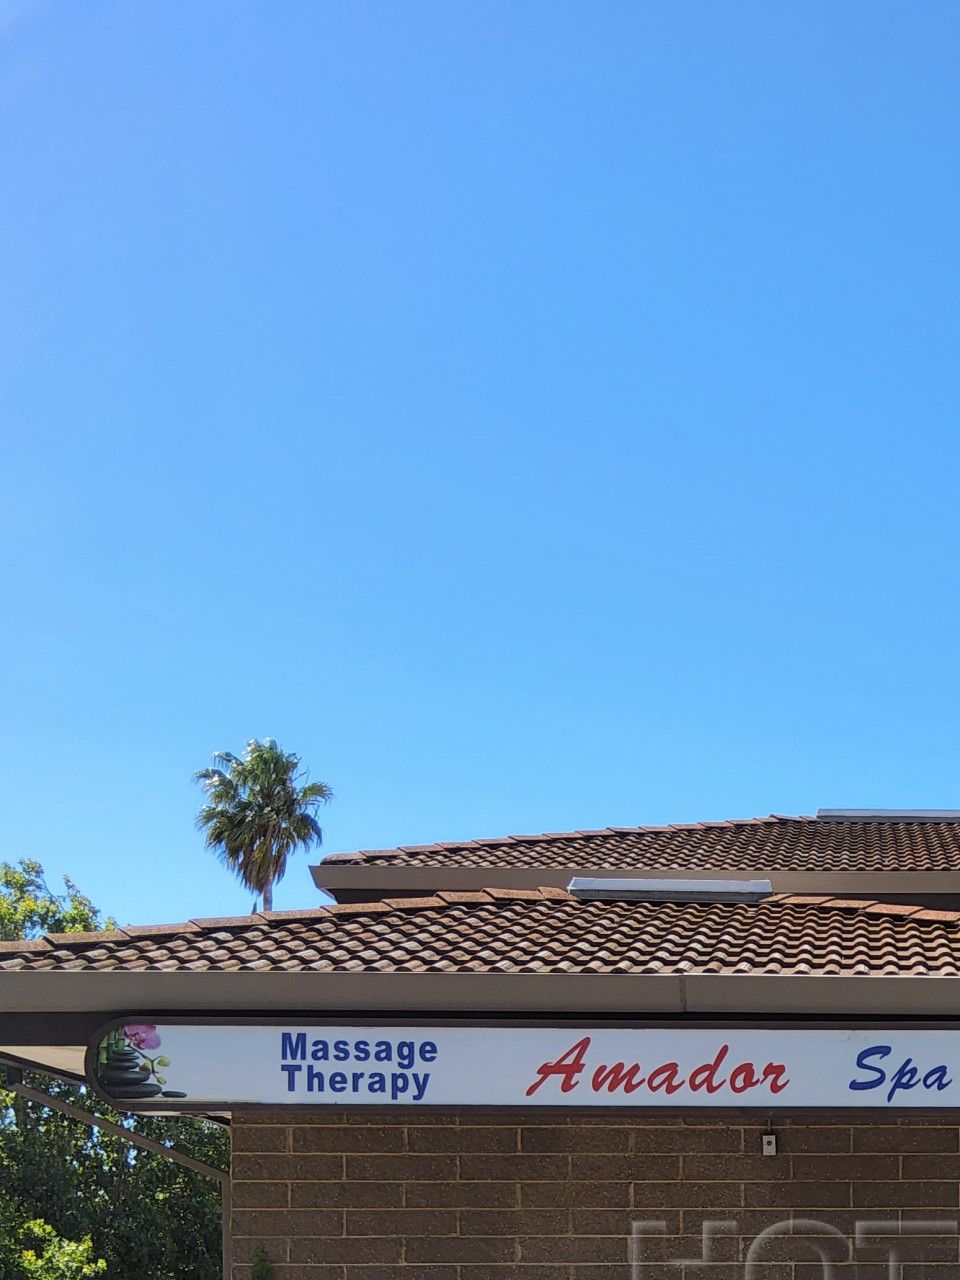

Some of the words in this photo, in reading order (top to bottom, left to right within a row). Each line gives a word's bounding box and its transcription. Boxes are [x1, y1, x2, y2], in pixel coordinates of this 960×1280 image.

[280, 1033, 438, 1068] Massage
[280, 1065, 431, 1100] Therapy
[526, 1036, 790, 1096] Amador
[849, 1045, 953, 1102] Spa
